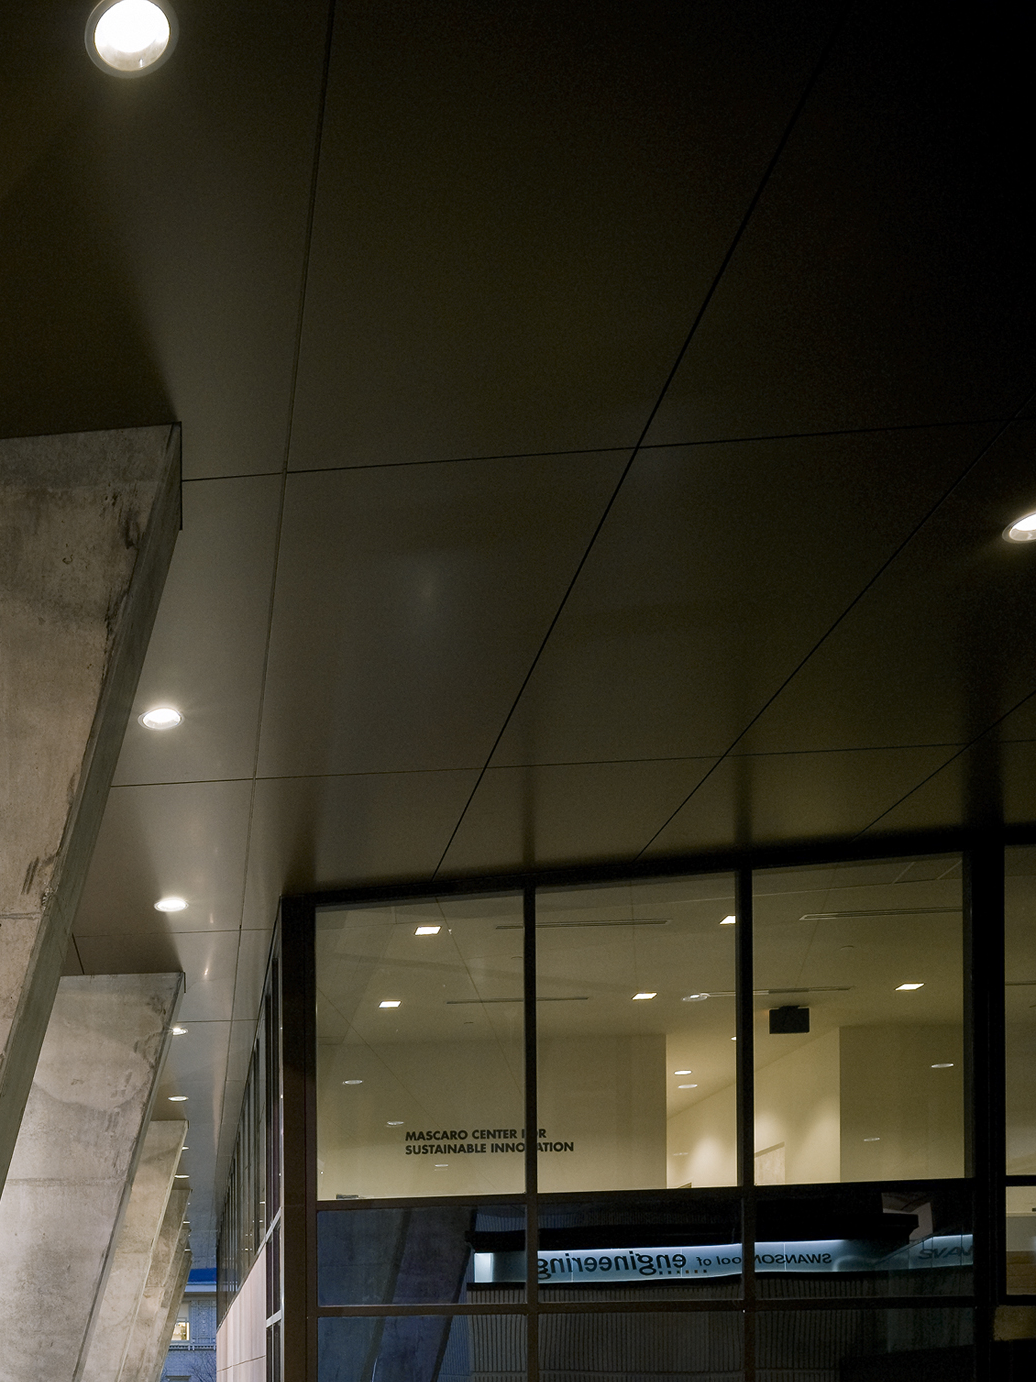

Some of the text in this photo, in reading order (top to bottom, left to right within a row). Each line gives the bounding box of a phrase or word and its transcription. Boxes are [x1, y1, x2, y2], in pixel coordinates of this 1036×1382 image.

[405, 1130, 468, 1141] MASCARO
[471, 1129, 518, 1140] CENTER
[405, 1141, 574, 1155] SUSTAINABLE INNOATION
